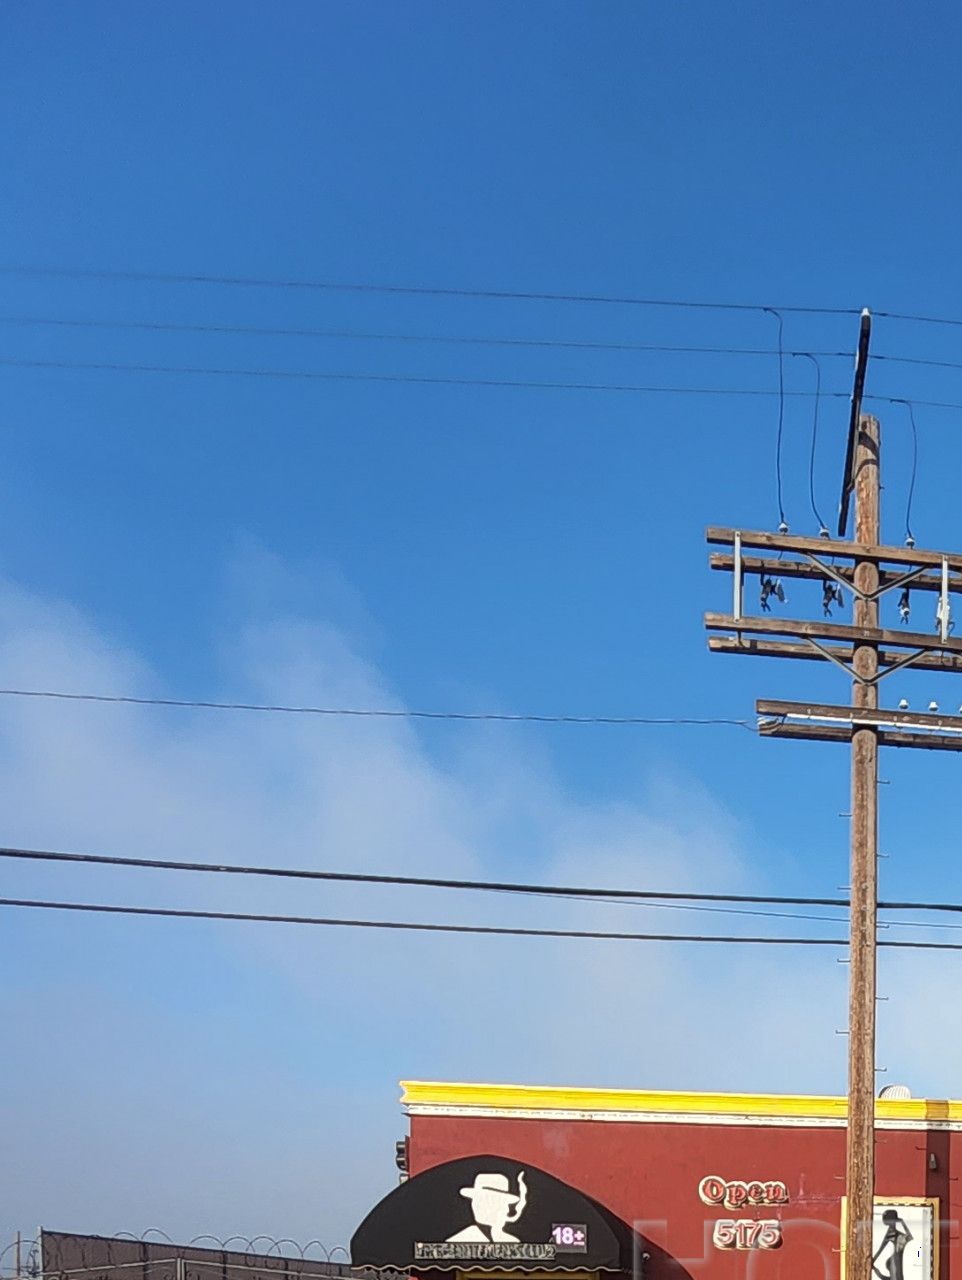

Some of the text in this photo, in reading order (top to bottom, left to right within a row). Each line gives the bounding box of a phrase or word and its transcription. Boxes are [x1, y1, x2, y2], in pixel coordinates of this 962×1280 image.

[699, 1176, 787, 1210] Open
[552, 1226, 585, 1246] 18+
[713, 1219, 783, 1250] 5175
